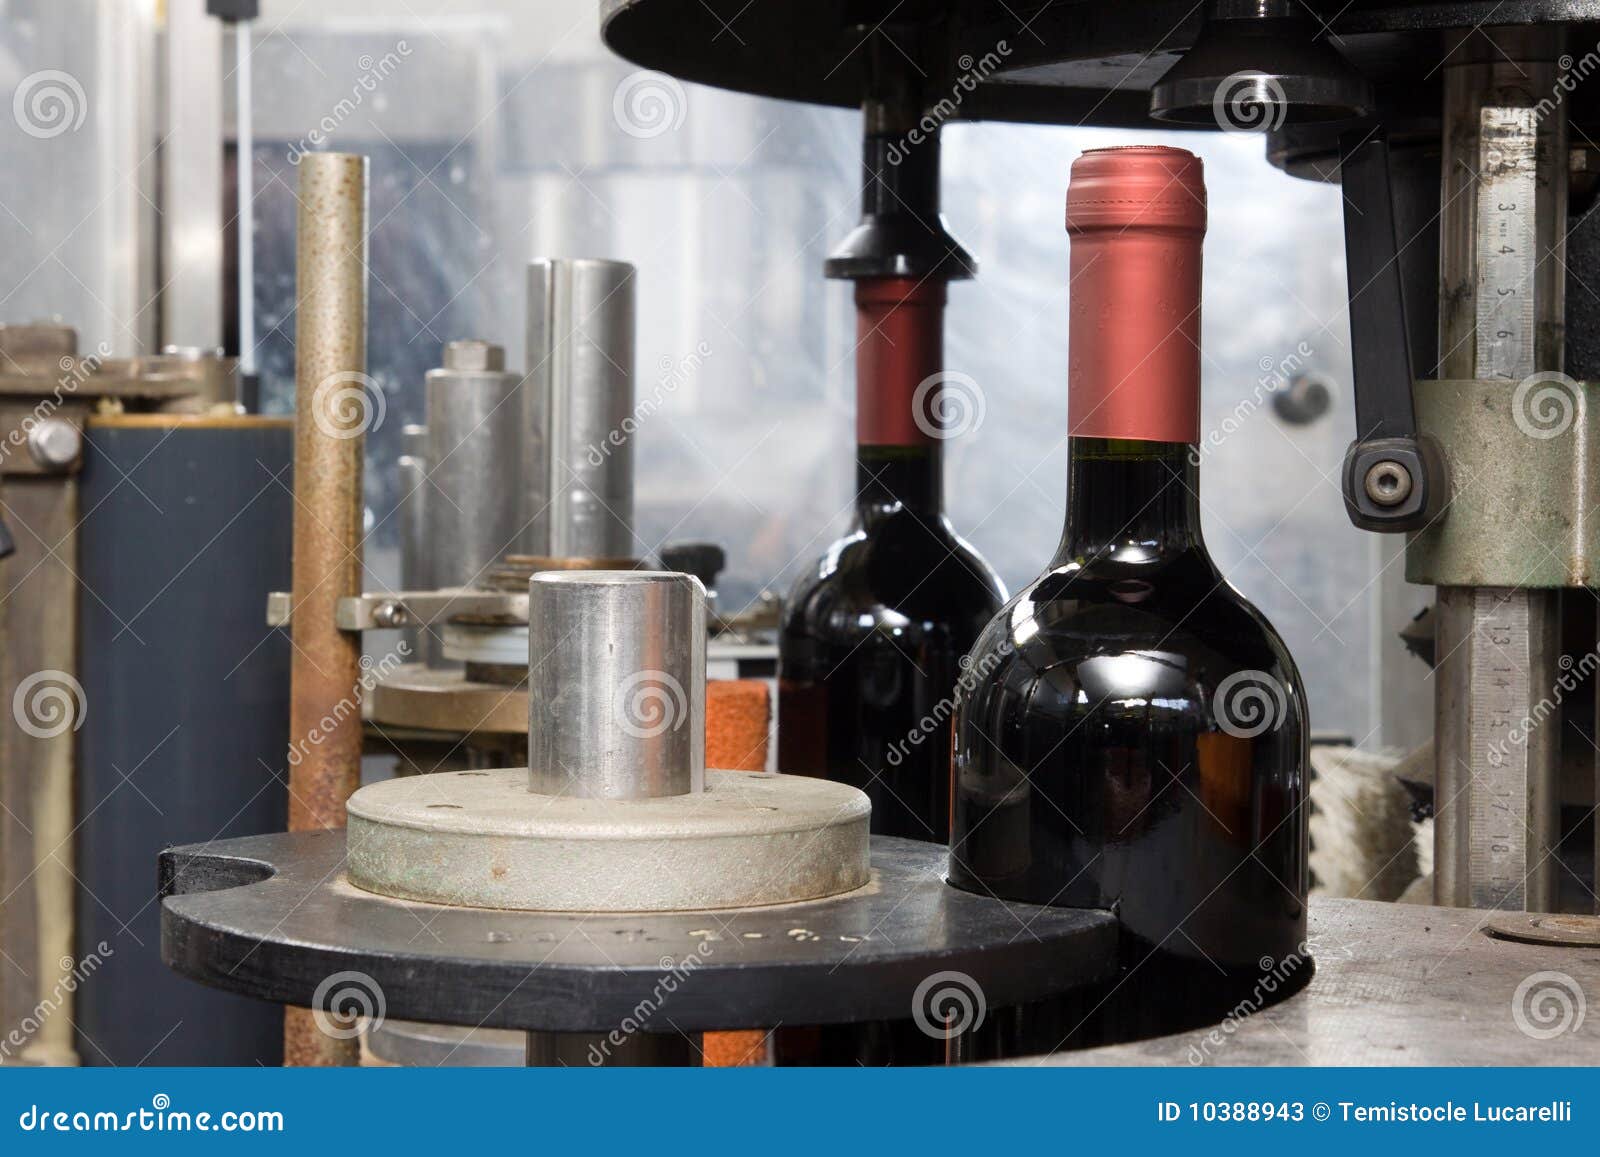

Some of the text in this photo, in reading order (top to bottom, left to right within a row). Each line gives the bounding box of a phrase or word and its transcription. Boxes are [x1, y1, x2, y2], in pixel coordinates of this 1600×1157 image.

[1498, 203, 1516, 211] 3
[1498, 245, 1516, 254] 4
[1497, 287, 1516, 296] 5
[1497, 330, 1514, 338] 6
[1492, 626, 1511, 645] 13
[1491, 835, 1510, 852] 18
